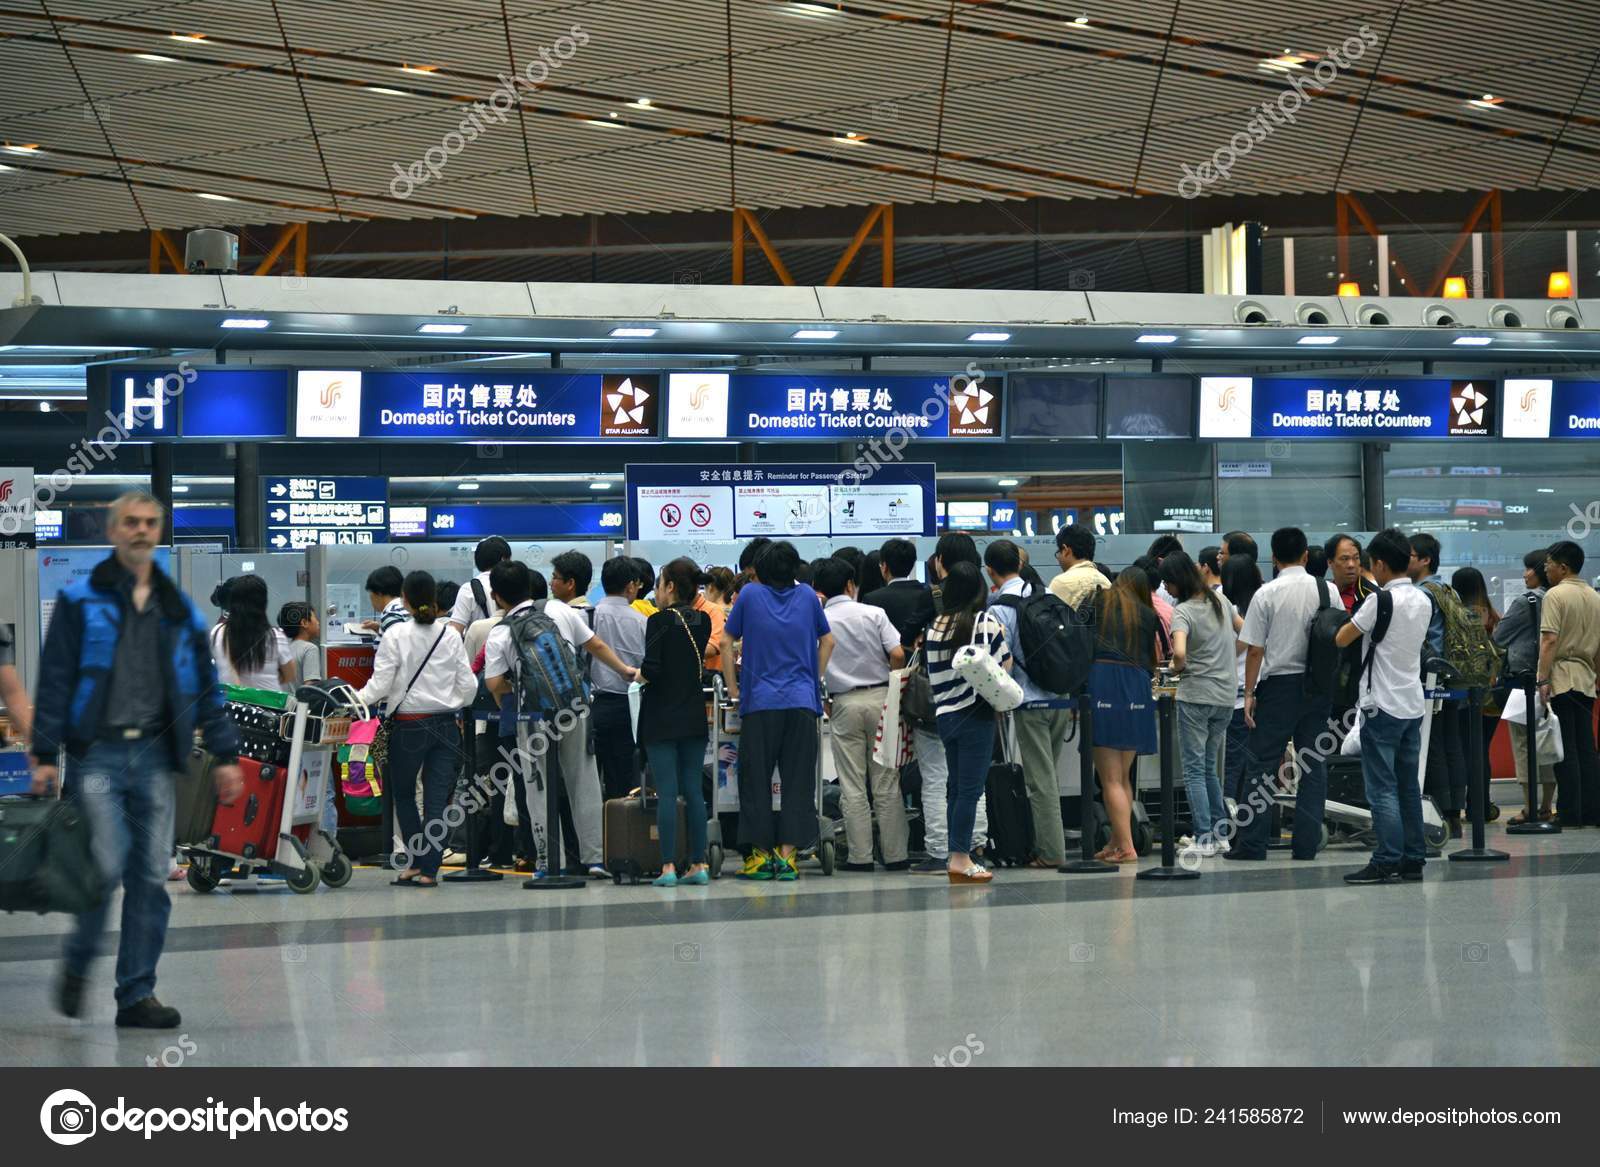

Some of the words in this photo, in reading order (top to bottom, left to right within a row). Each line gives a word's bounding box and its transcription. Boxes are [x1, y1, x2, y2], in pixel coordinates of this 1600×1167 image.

[423, 384, 538, 408] 国内售票处
[787, 388, 893, 411] 国内售票处
[1306, 389, 1400, 412] 国内售票处
[124, 378, 164, 430] H
[381, 410, 454, 425] Domestic
[457, 410, 504, 425] Ticket
[506, 410, 576, 425] Counters
[748, 413, 816, 428] Domestic
[819, 413, 862, 427] Ticket
[864, 413, 929, 427] Counters
[1272, 413, 1332, 427] Domestic
[1335, 413, 1373, 427] Ticket
[1374, 413, 1432, 427] Counters
[605, 427, 620, 435] STAR
[621, 427, 649, 435] ALLIANCE
[952, 427, 966, 435] STAR
[967, 427, 993, 435] ALLIANCE
[700, 470, 764, 481] 安全信息提示
[768, 472, 798, 480] Reminder
[799, 472, 809, 480] for
[810, 472, 844, 482] Passenger
[845, 472, 866, 481] Safety
[432, 515, 455, 528] J21
[599, 512, 622, 527] J20
[992, 508, 1014, 522] J17
